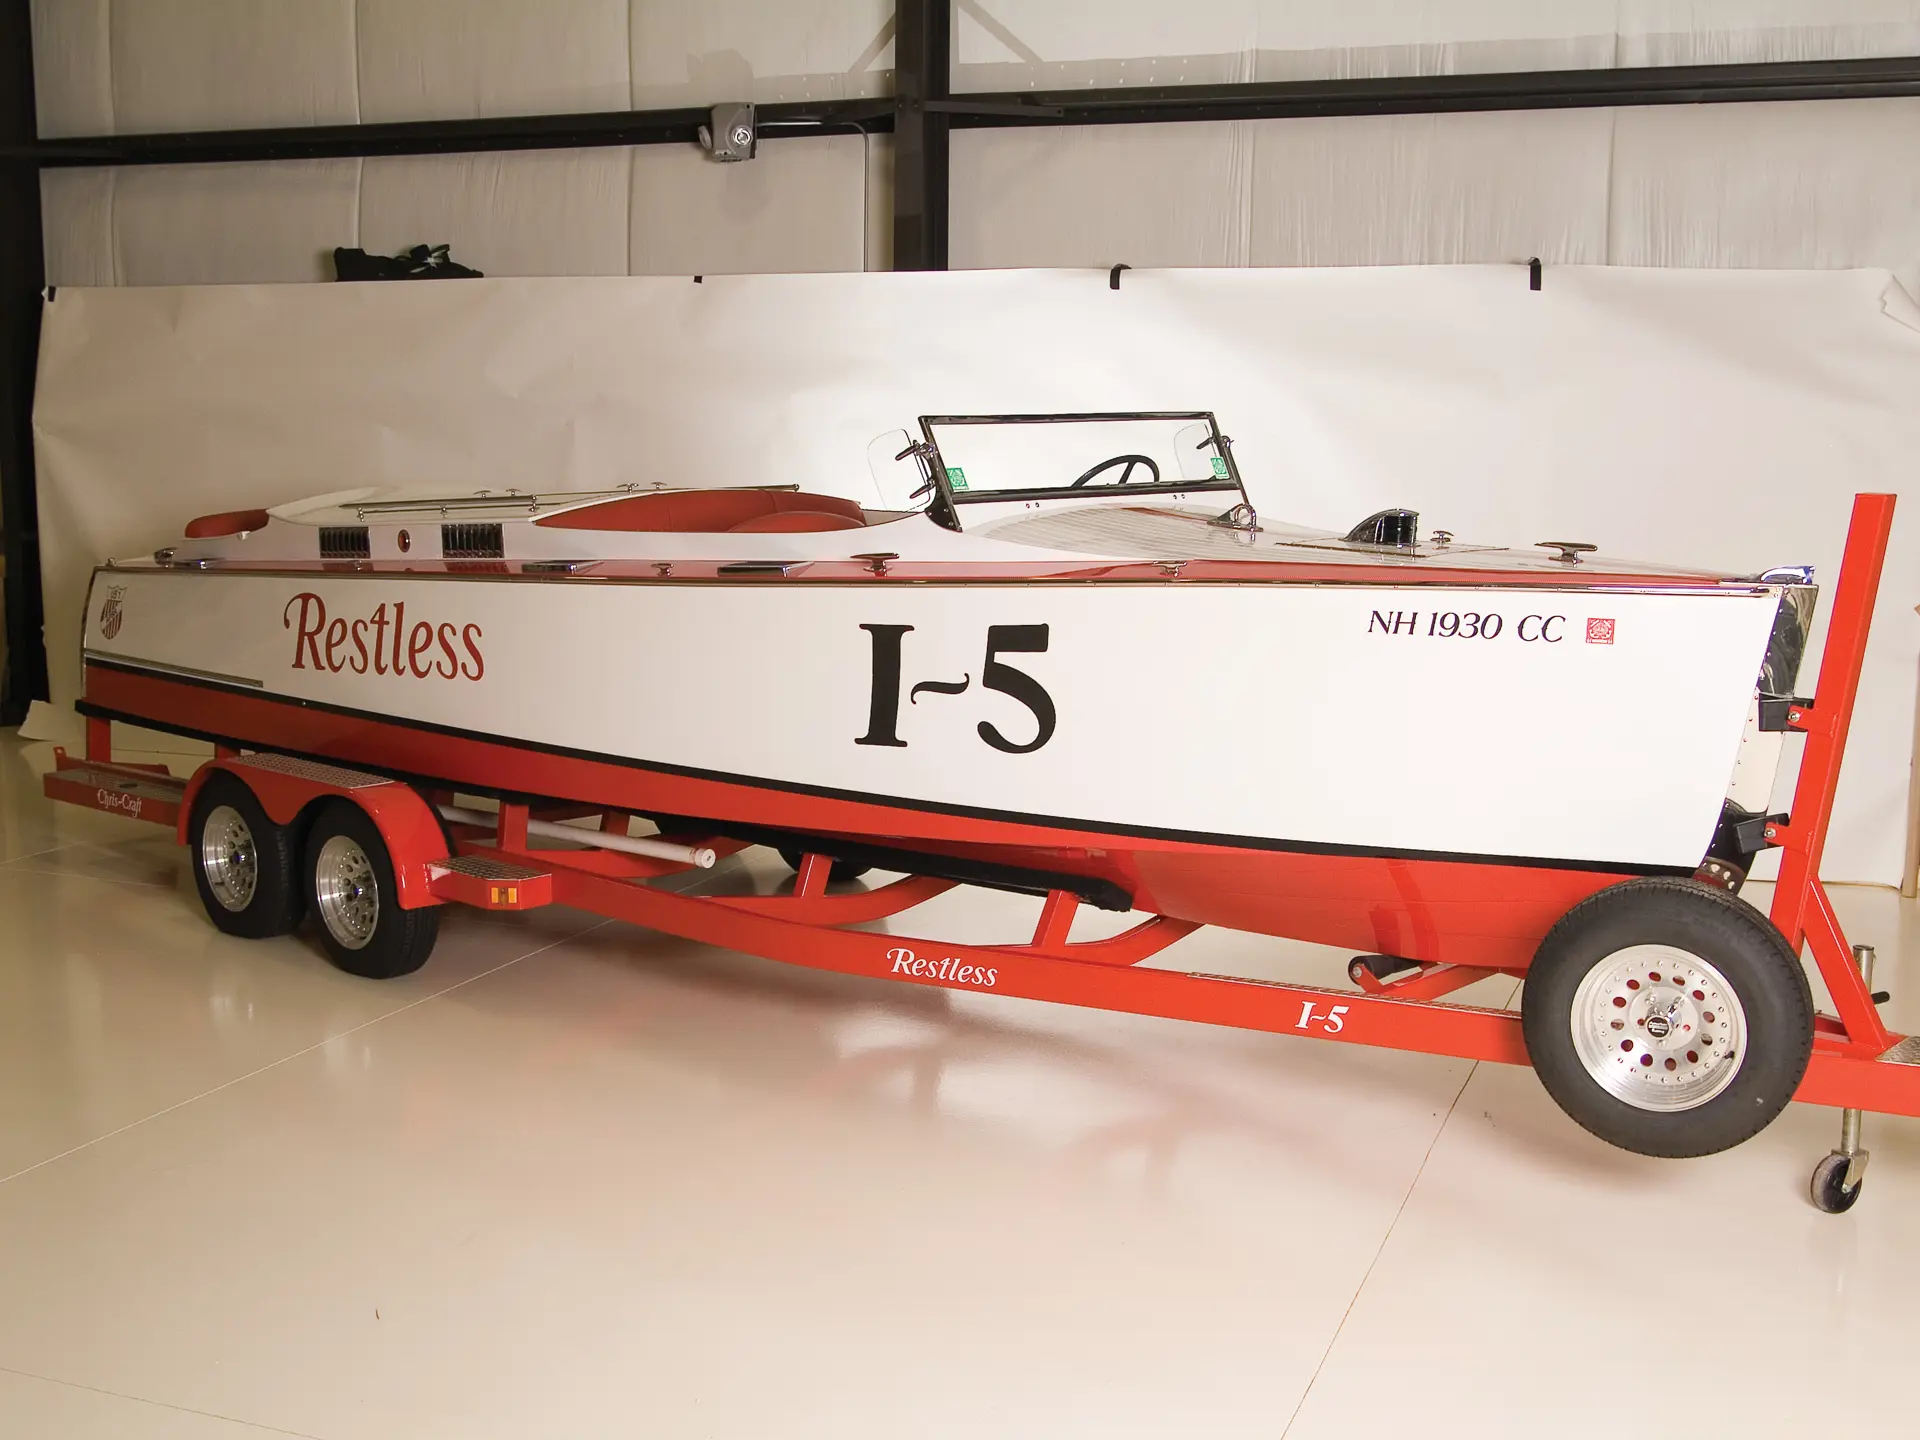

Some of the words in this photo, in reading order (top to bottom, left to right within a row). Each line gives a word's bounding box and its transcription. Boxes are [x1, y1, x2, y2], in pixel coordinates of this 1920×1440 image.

[284, 592, 485, 682] Restless
[1367, 610, 1419, 636] NH
[1427, 611, 1504, 640] 1930
[1516, 614, 1567, 643] CC
[97, 788, 142, 818] Chris-Craft
[886, 948, 999, 987] Restless
